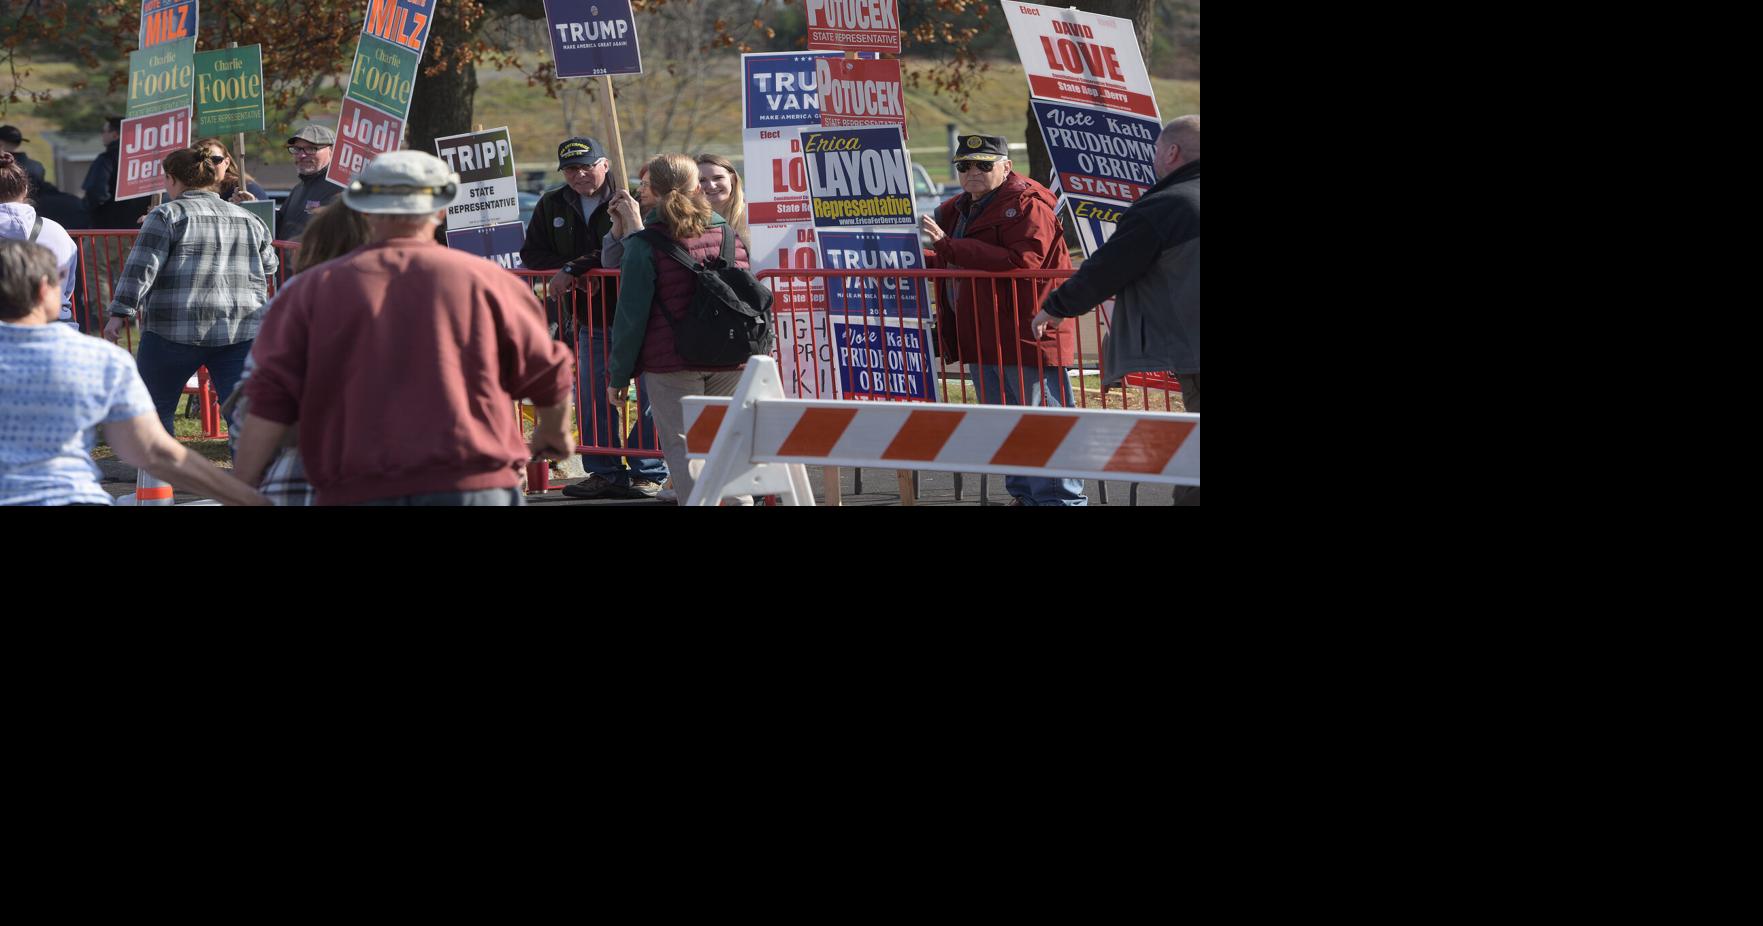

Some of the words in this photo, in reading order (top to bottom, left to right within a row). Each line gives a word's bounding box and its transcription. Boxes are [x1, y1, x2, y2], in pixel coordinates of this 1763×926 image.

[806, 0, 897, 29] POTUCEK
[1019, 5, 1041, 17] Elect
[144, 4, 189, 48] MILZ
[366, 0, 428, 49] MILZ
[555, 19, 628, 42] TRUMP
[1051, 19, 1094, 39] DAVID
[812, 31, 834, 41] STATE
[835, 33, 897, 45] REPRESENTATIVE
[149, 52, 176, 67] Charlie
[214, 57, 243, 72] Charlie
[375, 47, 401, 69] Charlie
[1039, 35, 1126, 82] LOVE
[130, 63, 191, 100] Foote
[198, 70, 260, 104] Foote
[351, 53, 411, 104] Foote
[753, 71, 817, 93] TRU
[816, 60, 903, 115] POTUCEK
[1057, 81, 1081, 93] State
[1081, 84, 1099, 97] Rep
[766, 94, 819, 111] VAN
[200, 115, 217, 126] STATE
[342, 108, 398, 153] Jodi
[1046, 108, 1095, 127] Vote
[1105, 117, 1153, 141] Kath
[125, 112, 185, 154] Jodi
[760, 131, 780, 139] Elect
[805, 133, 862, 152] Erica
[1046, 126, 1157, 162] PRUDHOMM
[338, 143, 371, 173] Der
[440, 139, 509, 173] TRIPP
[127, 159, 164, 181] Der
[772, 156, 808, 193] LO
[806, 148, 909, 197] LAYON
[1077, 153, 1157, 185] O'BRIEN
[469, 186, 495, 198] STATE
[1069, 175, 1133, 199] STATE
[448, 197, 516, 215] REPRESENTATIVE
[777, 203, 800, 213] State
[813, 195, 912, 220] Representative
[1075, 200, 1121, 223] Eric
[838, 216, 912, 226] www.EricaForDerry.com
[779, 246, 816, 282] LO
[826, 248, 916, 269] TRUMP
[808, 293, 824, 303] ep
[859, 370, 918, 395] OBRIEN
